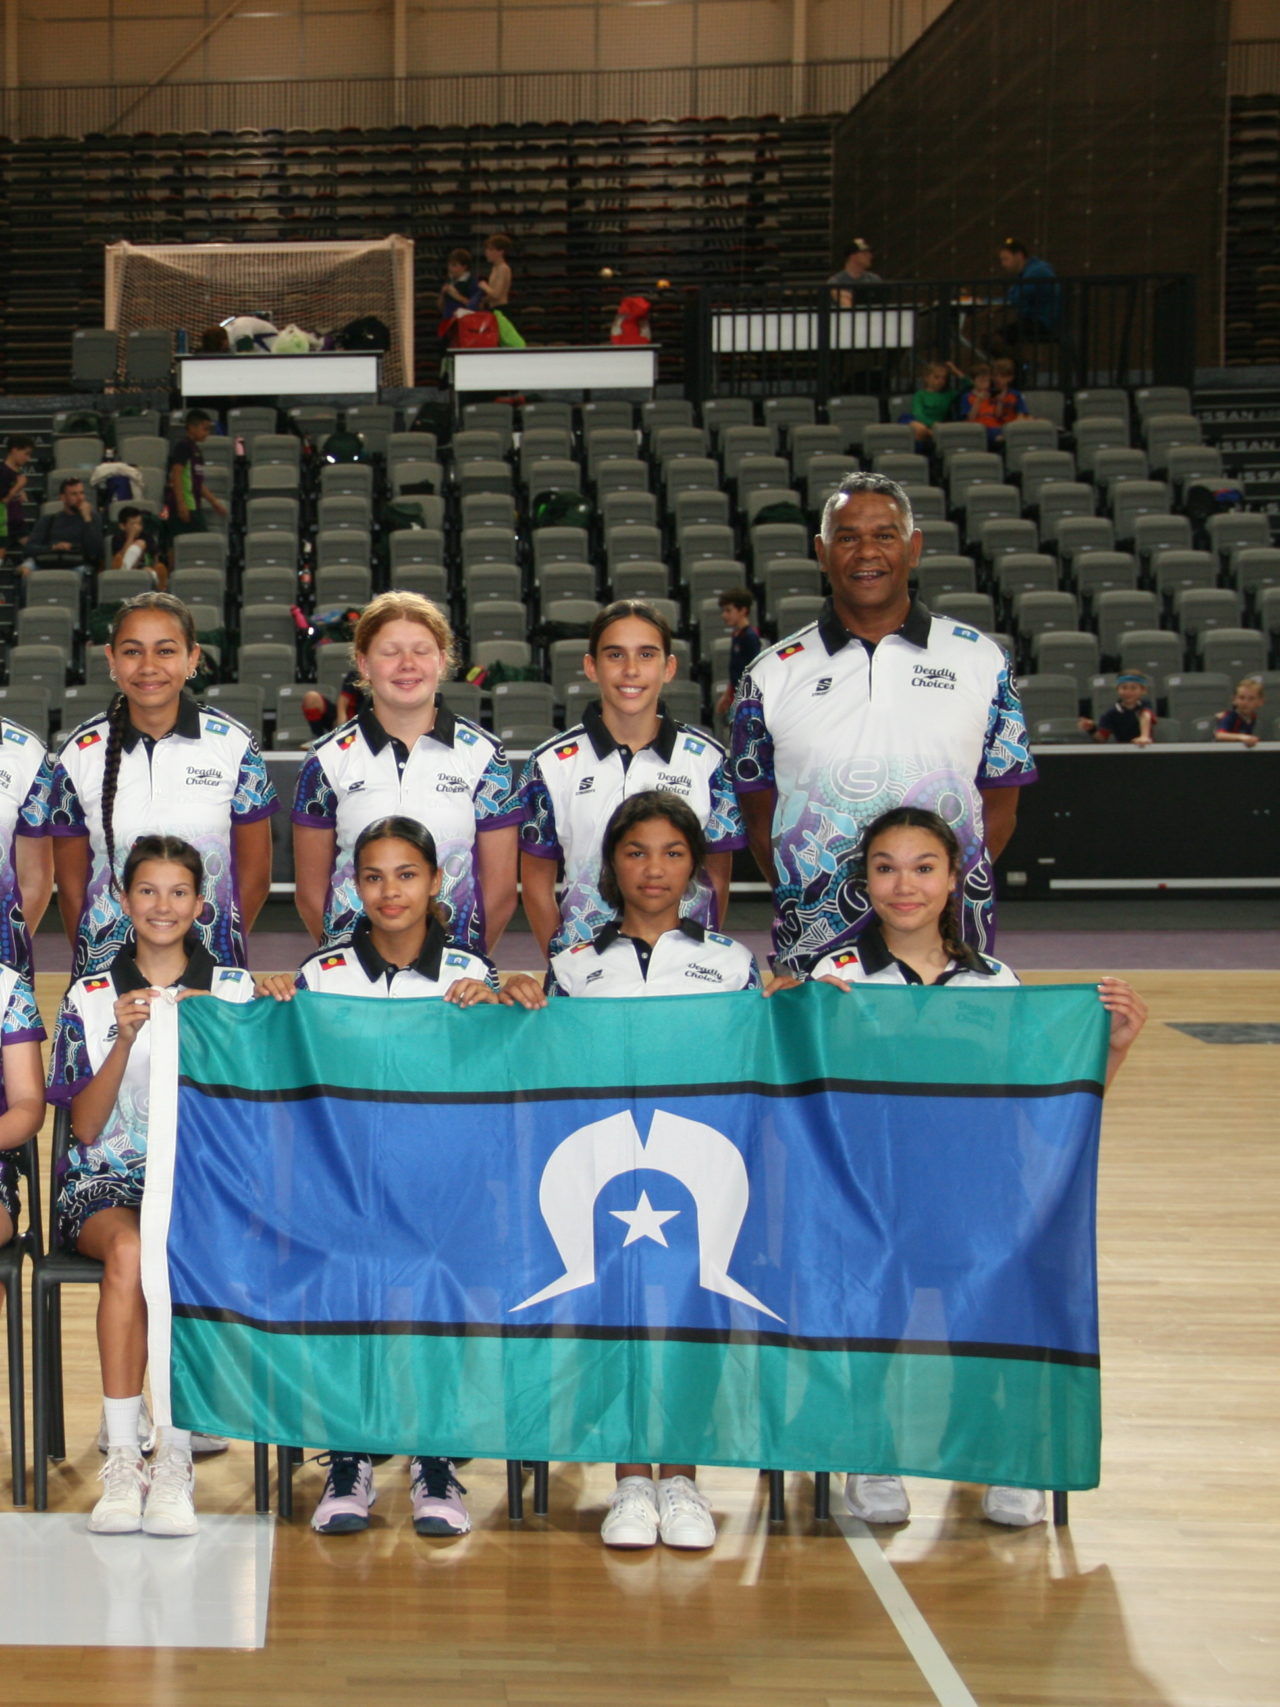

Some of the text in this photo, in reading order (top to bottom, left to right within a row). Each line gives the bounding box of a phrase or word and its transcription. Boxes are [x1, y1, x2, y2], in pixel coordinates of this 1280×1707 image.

[912, 664, 956, 681] Deadly
[911, 677, 955, 691] Choices
[185, 766, 223, 779] Deadly
[185, 777, 221, 787] Choices
[657, 772, 692, 788] Deadly
[655, 783, 691, 796] Choices
